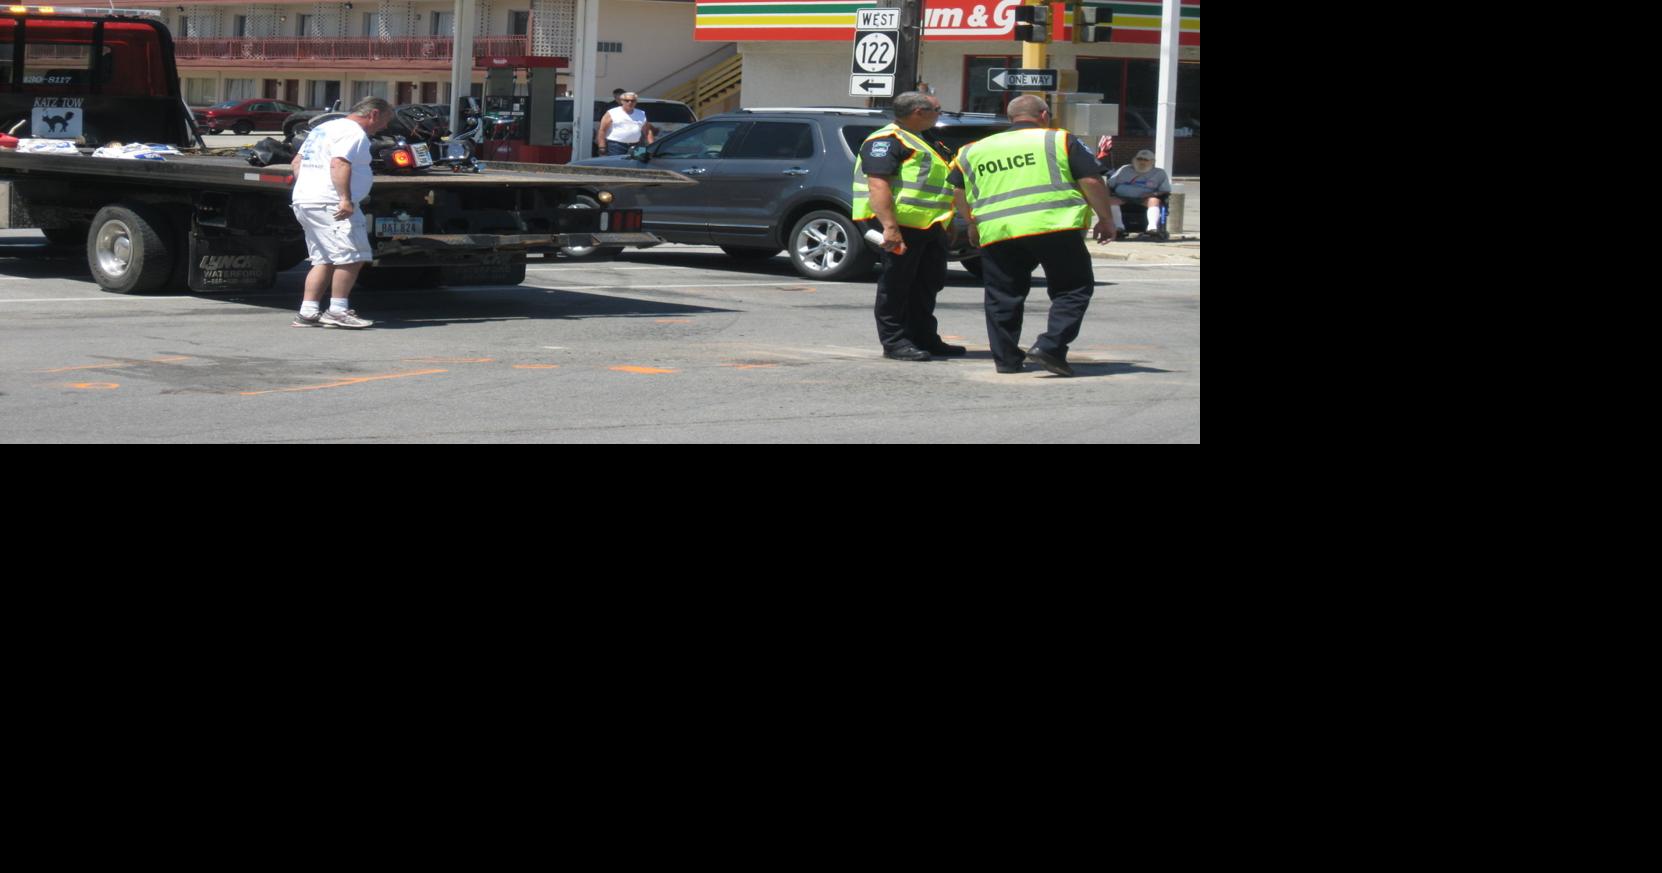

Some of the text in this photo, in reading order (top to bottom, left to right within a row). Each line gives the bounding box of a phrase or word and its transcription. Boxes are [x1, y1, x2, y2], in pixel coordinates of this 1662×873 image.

[863, 13, 895, 26] WEST
[967, 5, 988, 27] &
[861, 42, 890, 64] 122
[1009, 75, 1049, 84] ONE WAY
[34, 97, 84, 107] KATZ TOW
[978, 153, 1036, 176] POLICE
